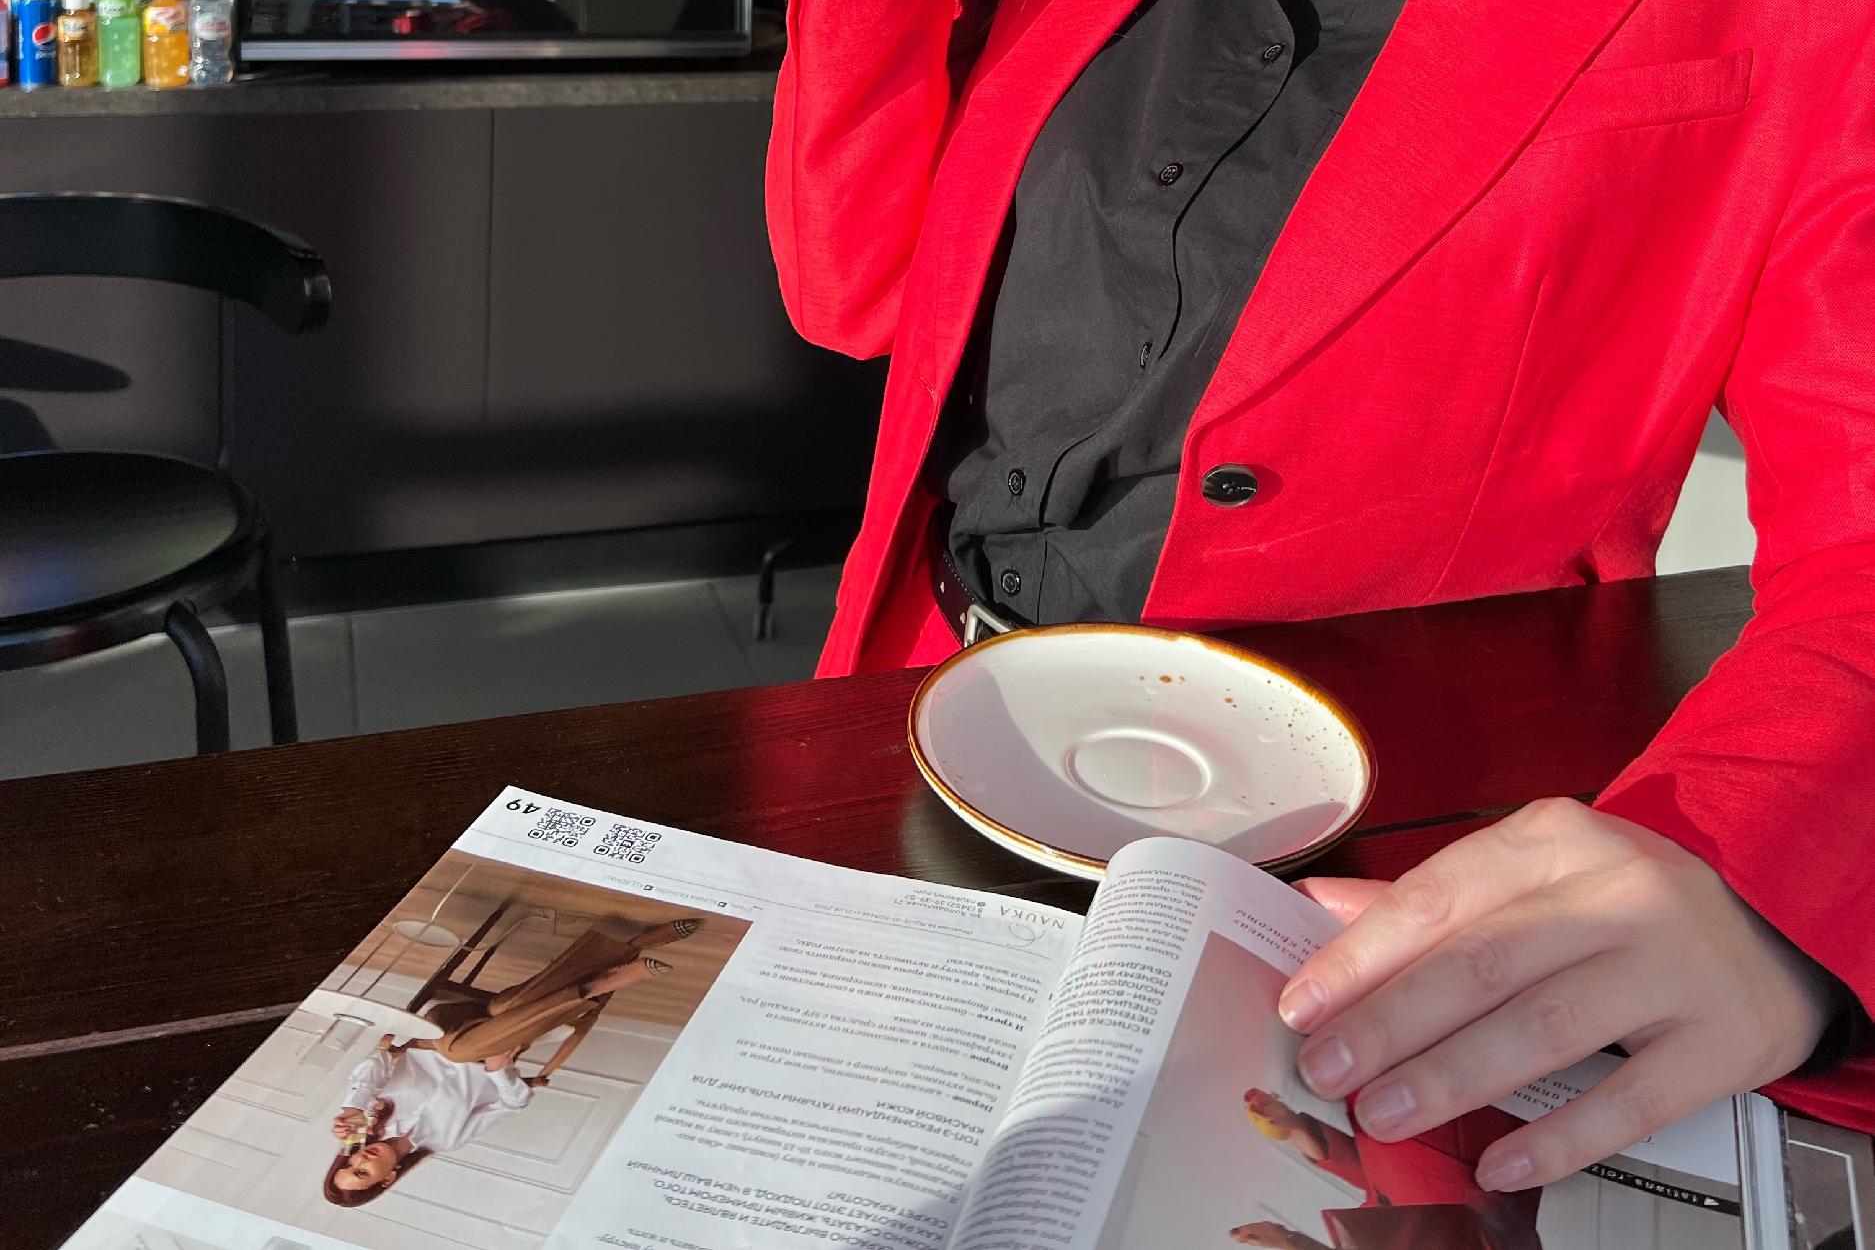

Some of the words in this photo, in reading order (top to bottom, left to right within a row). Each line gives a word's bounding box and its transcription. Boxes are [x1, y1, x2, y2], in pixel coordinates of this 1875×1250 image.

[506, 799, 541, 814] 49
[997, 904, 1065, 928] NAUKA
[777, 943, 804, 955] свою
[803, 948, 857, 965] сохранить
[821, 942, 858, 956] долгие
[856, 958, 892, 971] можно
[870, 951, 930, 969] активность
[973, 962, 1010, 976] желаю
[892, 965, 924, 977] время
[923, 970, 952, 982] наше
[939, 964, 980, 979] красоту
[1018, 972, 1043, 985] чего
[959, 978, 980, 989] что
[975, 1011, 1014, 1029] третье
[967, 1052, 1010, 1071] Второе
[690, 1073, 719, 1087] ДЛЯ
[718, 1079, 782, 1100] РОЛЬЗИНГ
[780, 1092, 836, 1111] ТАТЬЯНЫ
[950, 1093, 993, 1113] Первое
[836, 1103, 942, 1135] РЕКОМЕНДАЦИЙ
[914, 1108, 985, 1135] КРАСИВОЙ
[941, 1127, 981, 1147] ТОП-3
[625, 1159, 684, 1180] ЛИЧНЫЙ
[683, 1172, 713, 1186] ВАШ
[713, 1178, 741, 1193] ЧЕМ
[687, 1187, 764, 1212] ПРИМЕРОМ
[811, 1200, 847, 1216] ЭТОТ
[825, 1190, 897, 1214] КРАСОТЫ?
[764, 1204, 818, 1223] ЖИВЫМ
[846, 1208, 915, 1233] РАБОТАЕТ
[895, 1206, 949, 1229] СЕКРЕТ
[748, 1214, 829, 1239] ВЫГЛЯДИТЕ
[913, 1225, 945, 1242] КАК
